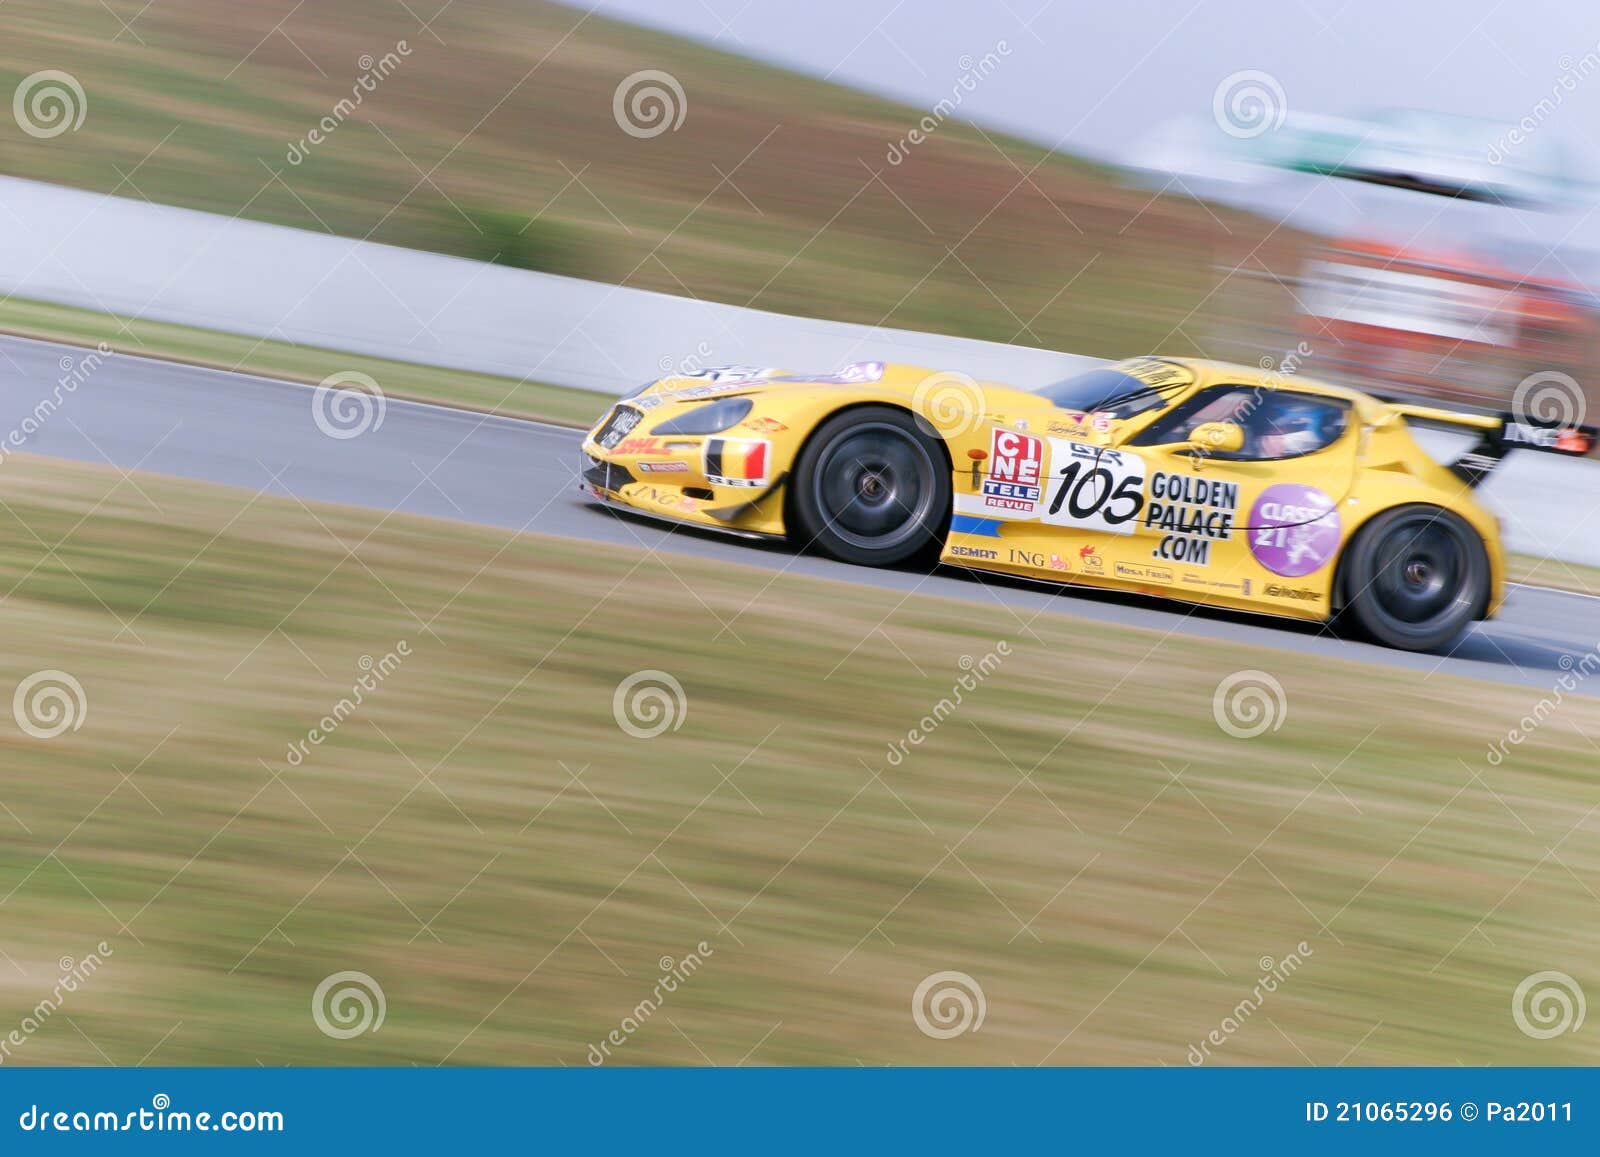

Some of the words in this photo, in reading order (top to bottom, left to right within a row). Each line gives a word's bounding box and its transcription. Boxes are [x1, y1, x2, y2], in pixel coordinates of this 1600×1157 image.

[985, 482, 1040, 499] TELE
[1048, 461, 1144, 525] 105
[1151, 471, 1238, 510] GOLDEN
[987, 498, 1034, 512] REVUE
[1145, 502, 1233, 539] PALACE
[1254, 524, 1288, 548] 21
[950, 545, 999, 560] SEMAT
[1008, 548, 1046, 567] ING
[1152, 535, 1209, 565] .COM
